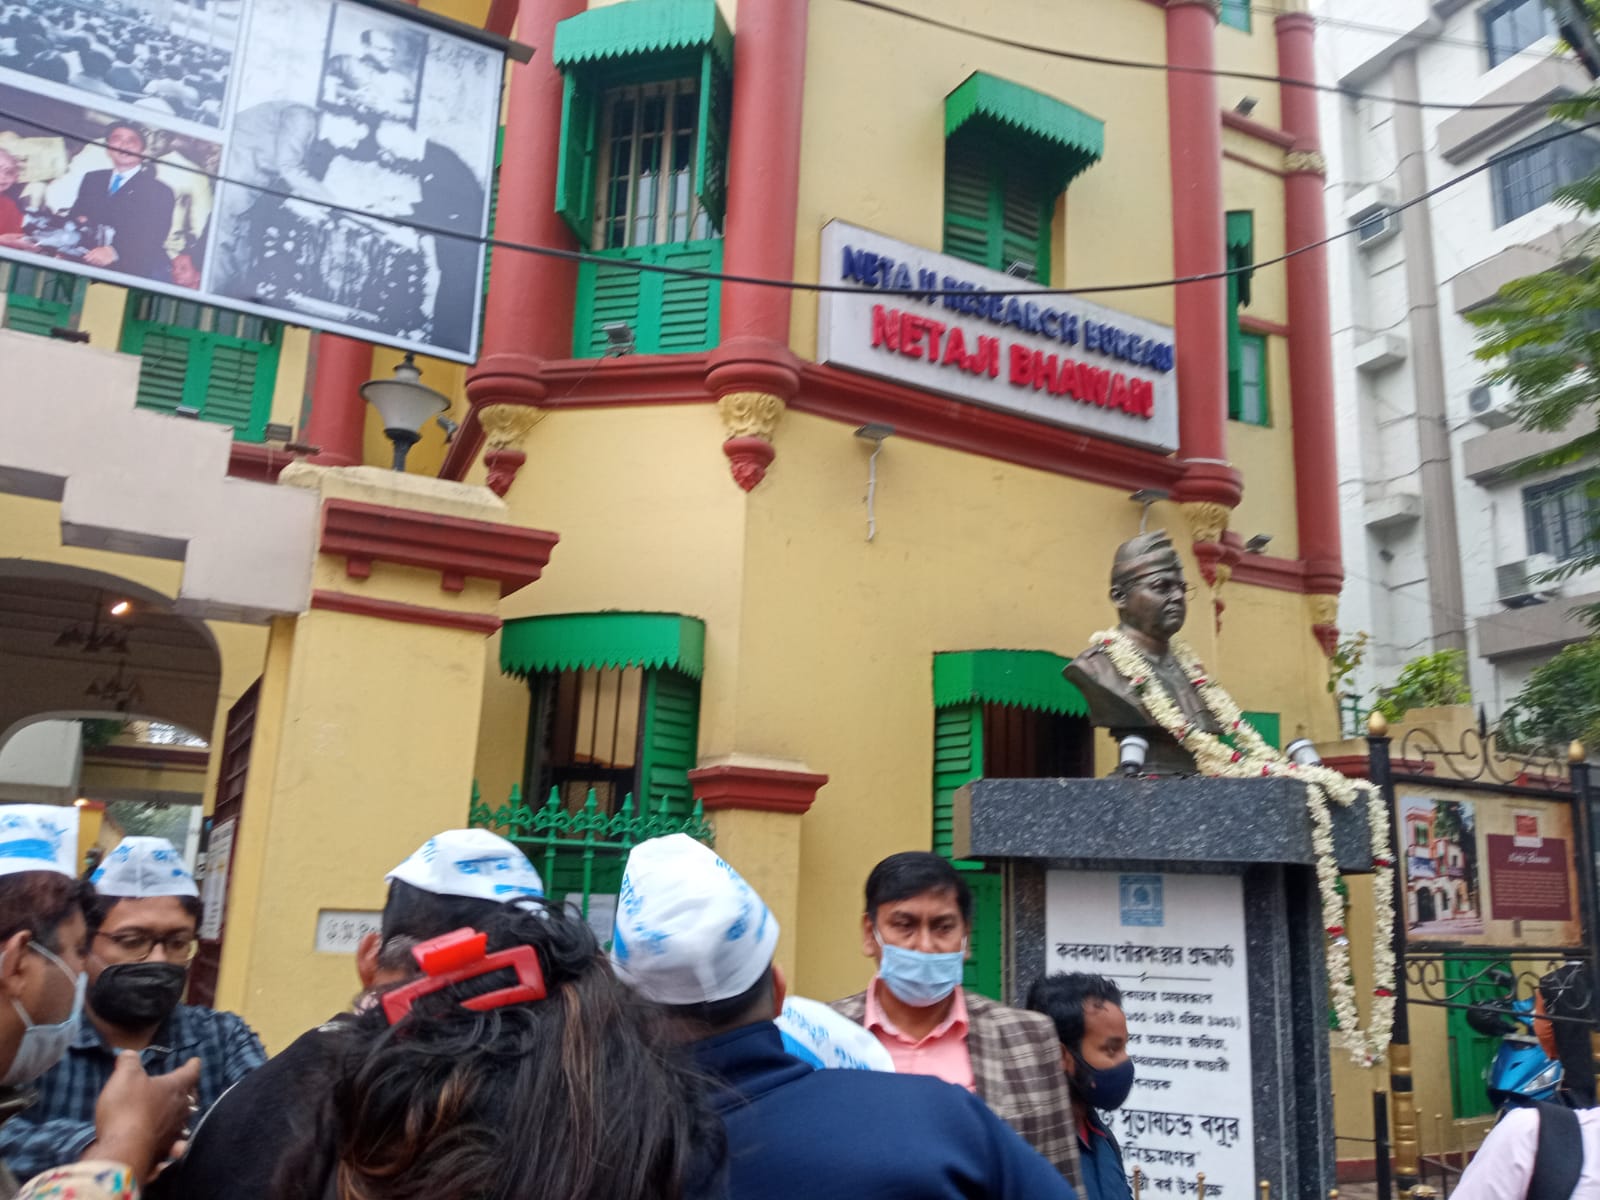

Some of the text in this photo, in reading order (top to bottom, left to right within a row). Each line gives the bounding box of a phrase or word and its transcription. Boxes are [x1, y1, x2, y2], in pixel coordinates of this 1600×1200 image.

[842, 244, 1174, 372] NETAJI RESEARCH BUREAU
[872, 304, 1154, 419] NETAJI BHAWAN
